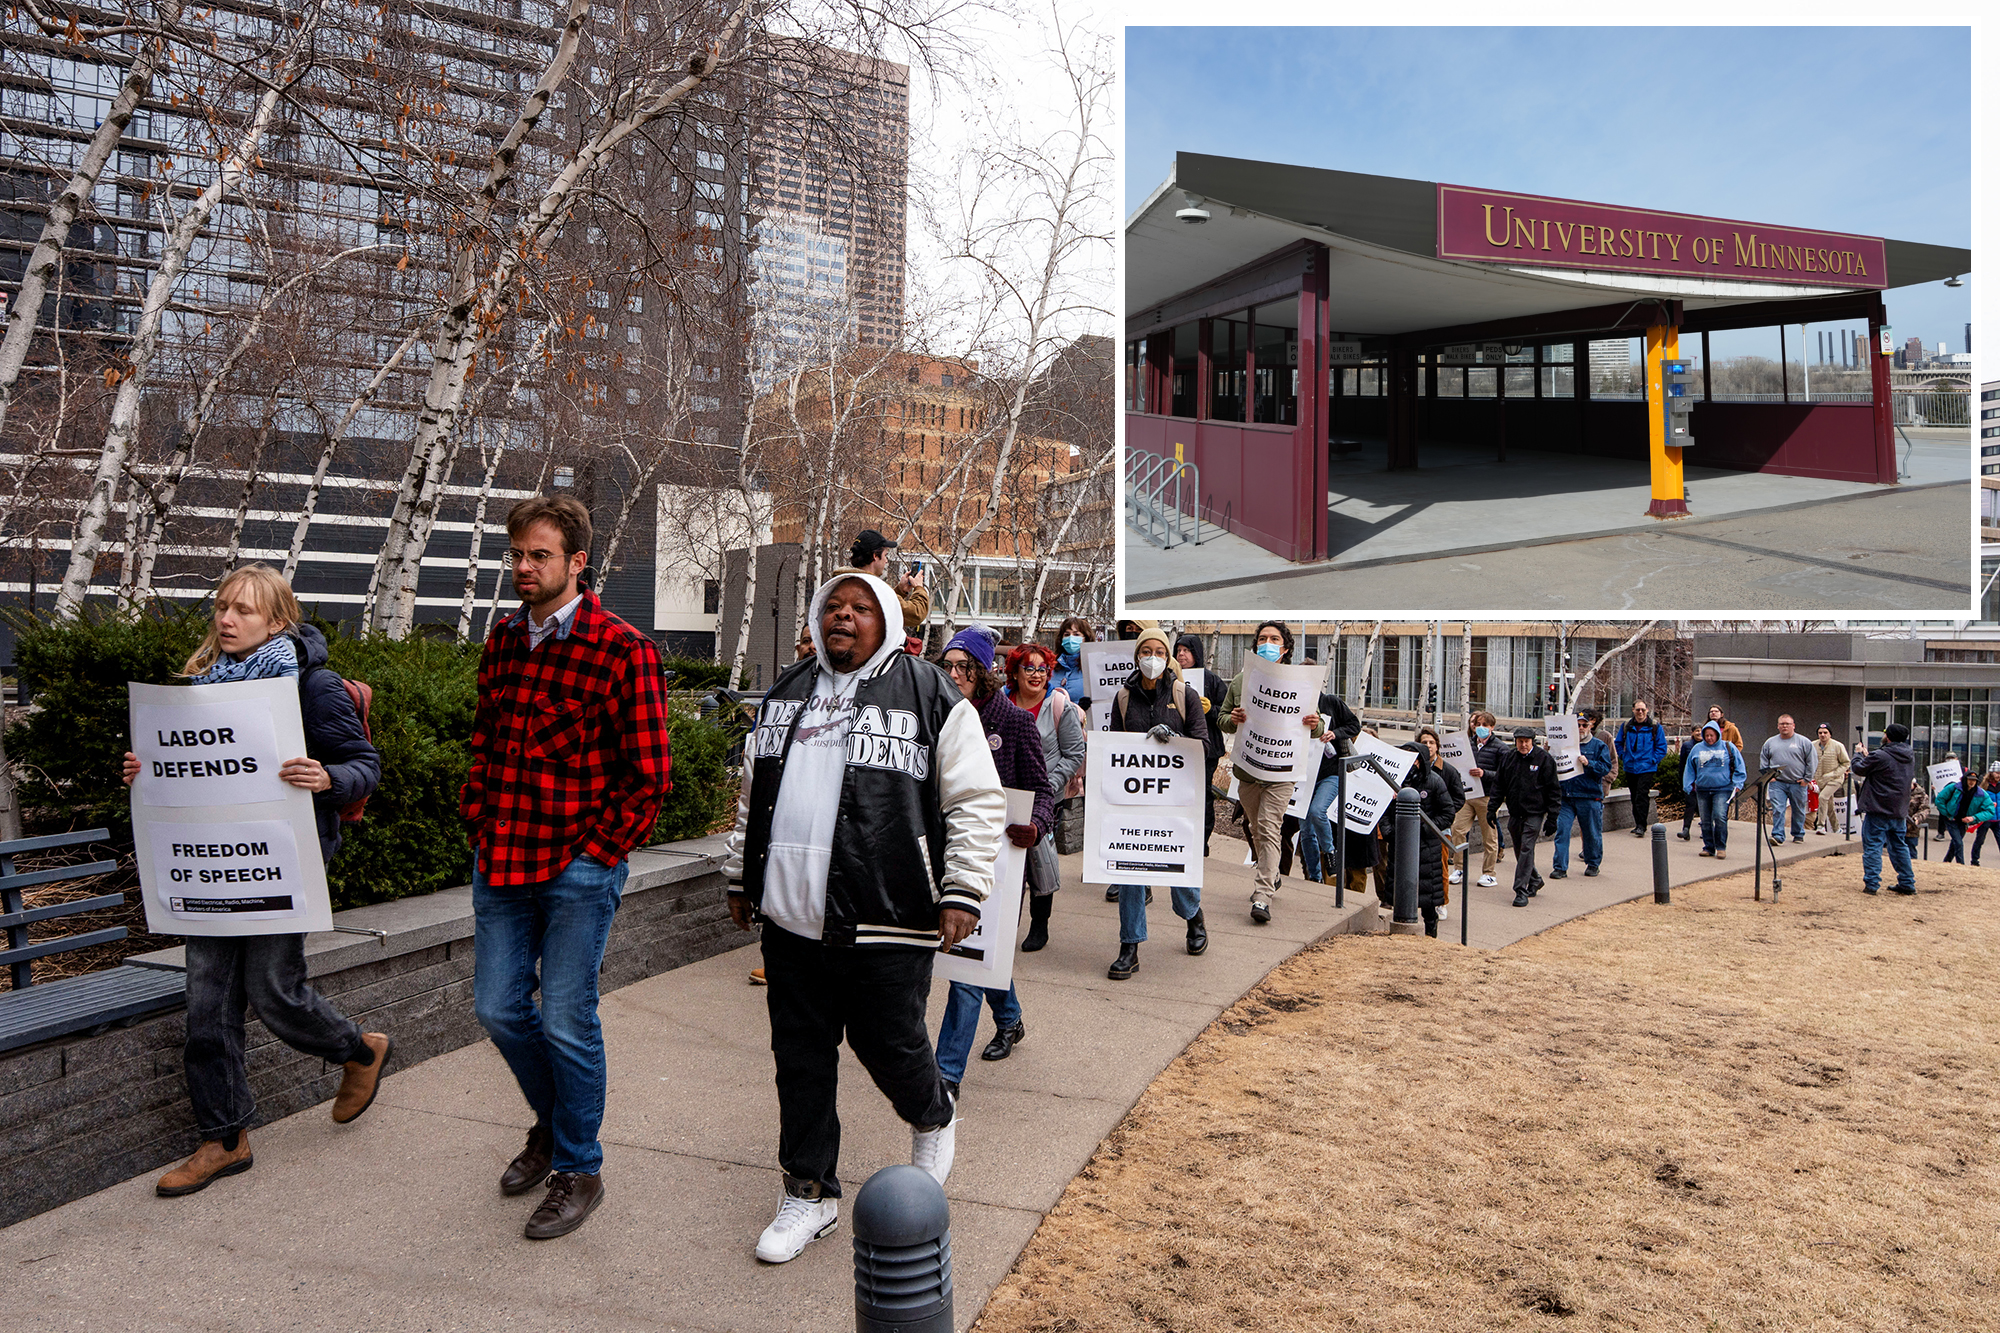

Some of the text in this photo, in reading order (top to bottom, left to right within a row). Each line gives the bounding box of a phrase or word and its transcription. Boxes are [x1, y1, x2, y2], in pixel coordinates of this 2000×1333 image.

[1482, 204, 1683, 262] UNIVERSITY
[1732, 232, 1868, 277] MINNESOTA
[1485, 353, 1503, 361] ONLY
[1099, 677, 1126, 686] DEFE
[1258, 684, 1298, 700] LABOR
[1251, 695, 1301, 714] DEFENDS
[157, 727, 236, 747] LABOR
[1248, 730, 1293, 747] FREEDOM
[1245, 740, 1294, 758] OF SPEECH
[152, 757, 258, 778] DEFENDS
[1111, 753, 1185, 769] HANDS
[1370, 752, 1401, 769] WE WILL
[1123, 777, 1171, 794] OFF
[1353, 792, 1378, 807] EACH
[1345, 802, 1374, 819] OTHER
[1120, 828, 1174, 838] THE FIRST
[171, 842, 269, 858] FREEDOM
[1109, 842, 1185, 852] AMENDEMENT
[170, 866, 282, 883] OF SPEECH
